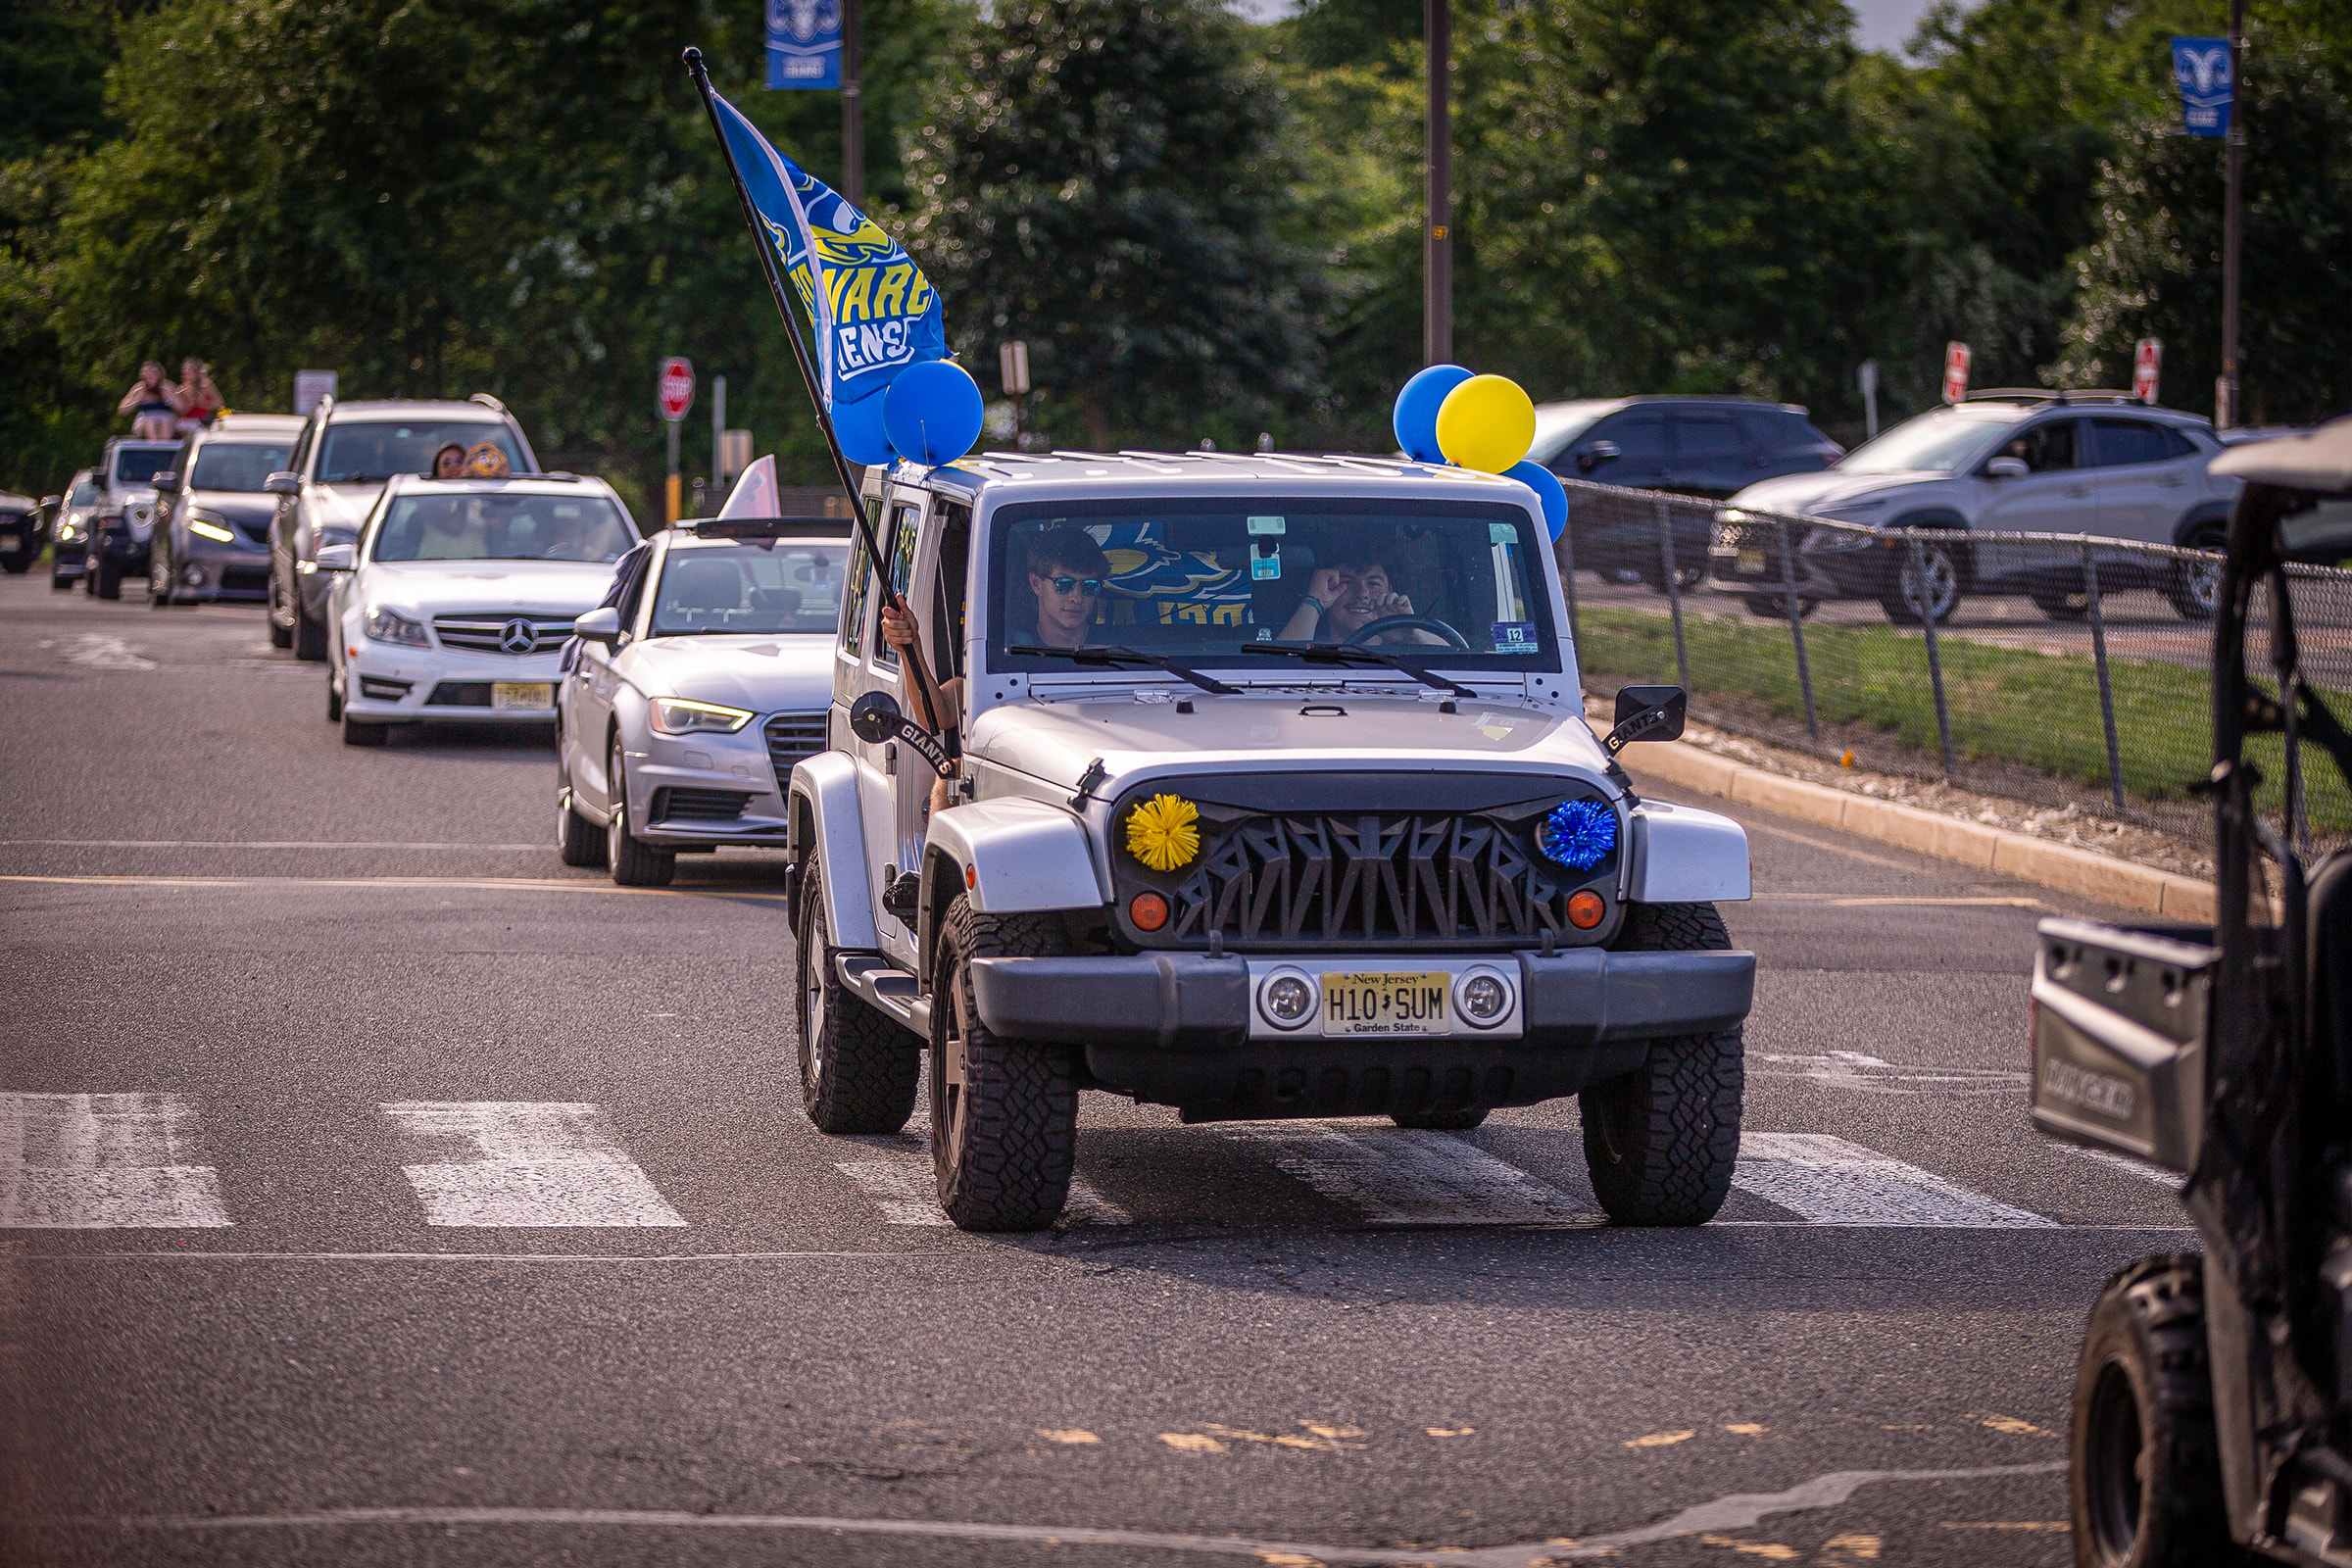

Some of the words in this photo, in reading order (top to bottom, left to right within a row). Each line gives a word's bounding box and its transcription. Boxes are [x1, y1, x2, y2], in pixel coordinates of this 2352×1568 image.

[1509, 629, 1522, 642] 12
[901, 724, 953, 775] GIANTS
[1352, 973, 1381, 984] New
[1383, 973, 1419, 986] Jersey
[1353, 1023, 1390, 1032] Garden
[1393, 1022, 1420, 1032] State
